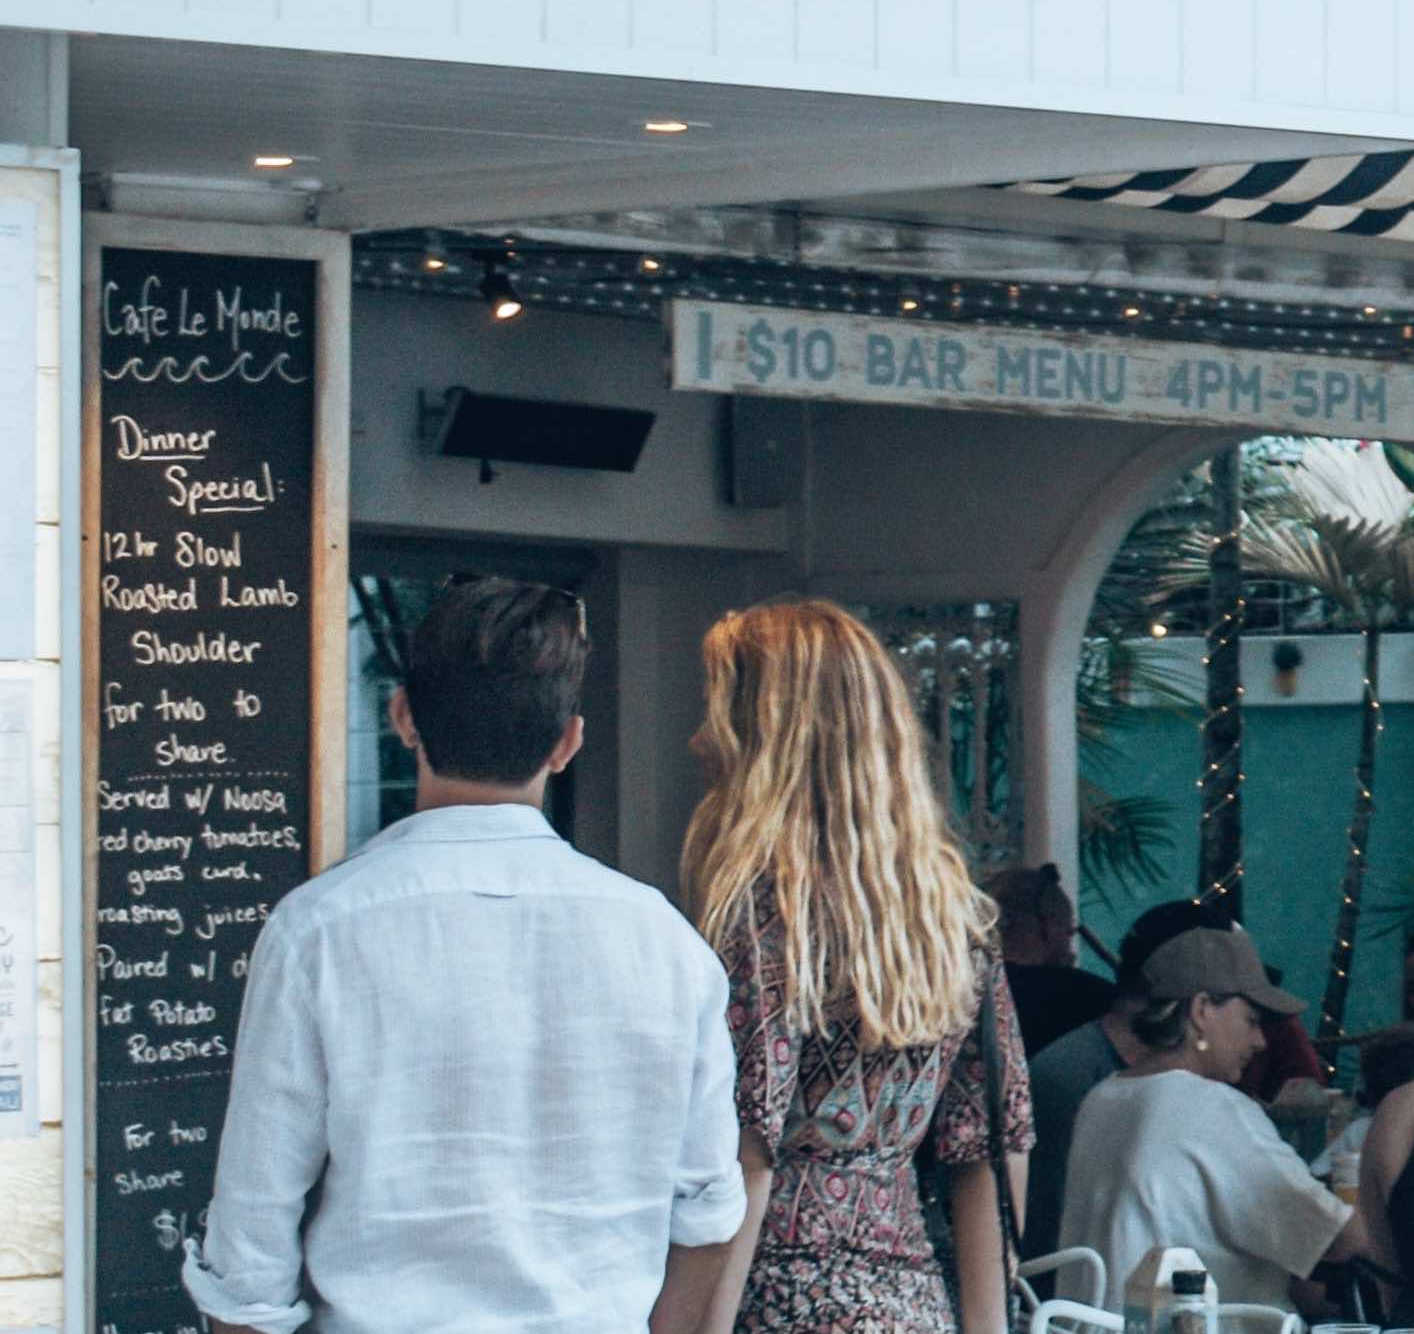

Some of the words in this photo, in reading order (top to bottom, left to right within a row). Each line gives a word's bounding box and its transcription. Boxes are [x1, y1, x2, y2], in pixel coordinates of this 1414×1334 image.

[104, 275, 168, 344] Cafe
[178, 287, 208, 336] Le
[216, 285, 301, 352] Monde
[745, 317, 836, 384] $10
[866, 333, 968, 393] BAR
[997, 345, 1128, 405] MENU
[1165, 358, 1388, 425] 4PM-5PM
[111, 415, 216, 461] Dinner
[165, 462, 286, 516] Special:
[175, 531, 242, 568] Slow
[102, 574, 199, 613] Roasted
[220, 575, 299, 608] Lamb
[131, 630, 262, 665] Shoulder
[154, 688, 207, 722] two
[232, 688, 262, 718] to
[96, 779, 171, 811] Served
[223, 785, 288, 814] Noosa
[132, 829, 193, 859] cherry
[127, 864, 185, 896] goats
[98, 904, 185, 935] roasting
[96, 943, 169, 982] Paired
[148, 998, 217, 1026] Potato
[126, 1033, 229, 1065] Roasties
[123, 1122, 156, 1151] For
[168, 1119, 208, 1146] two
